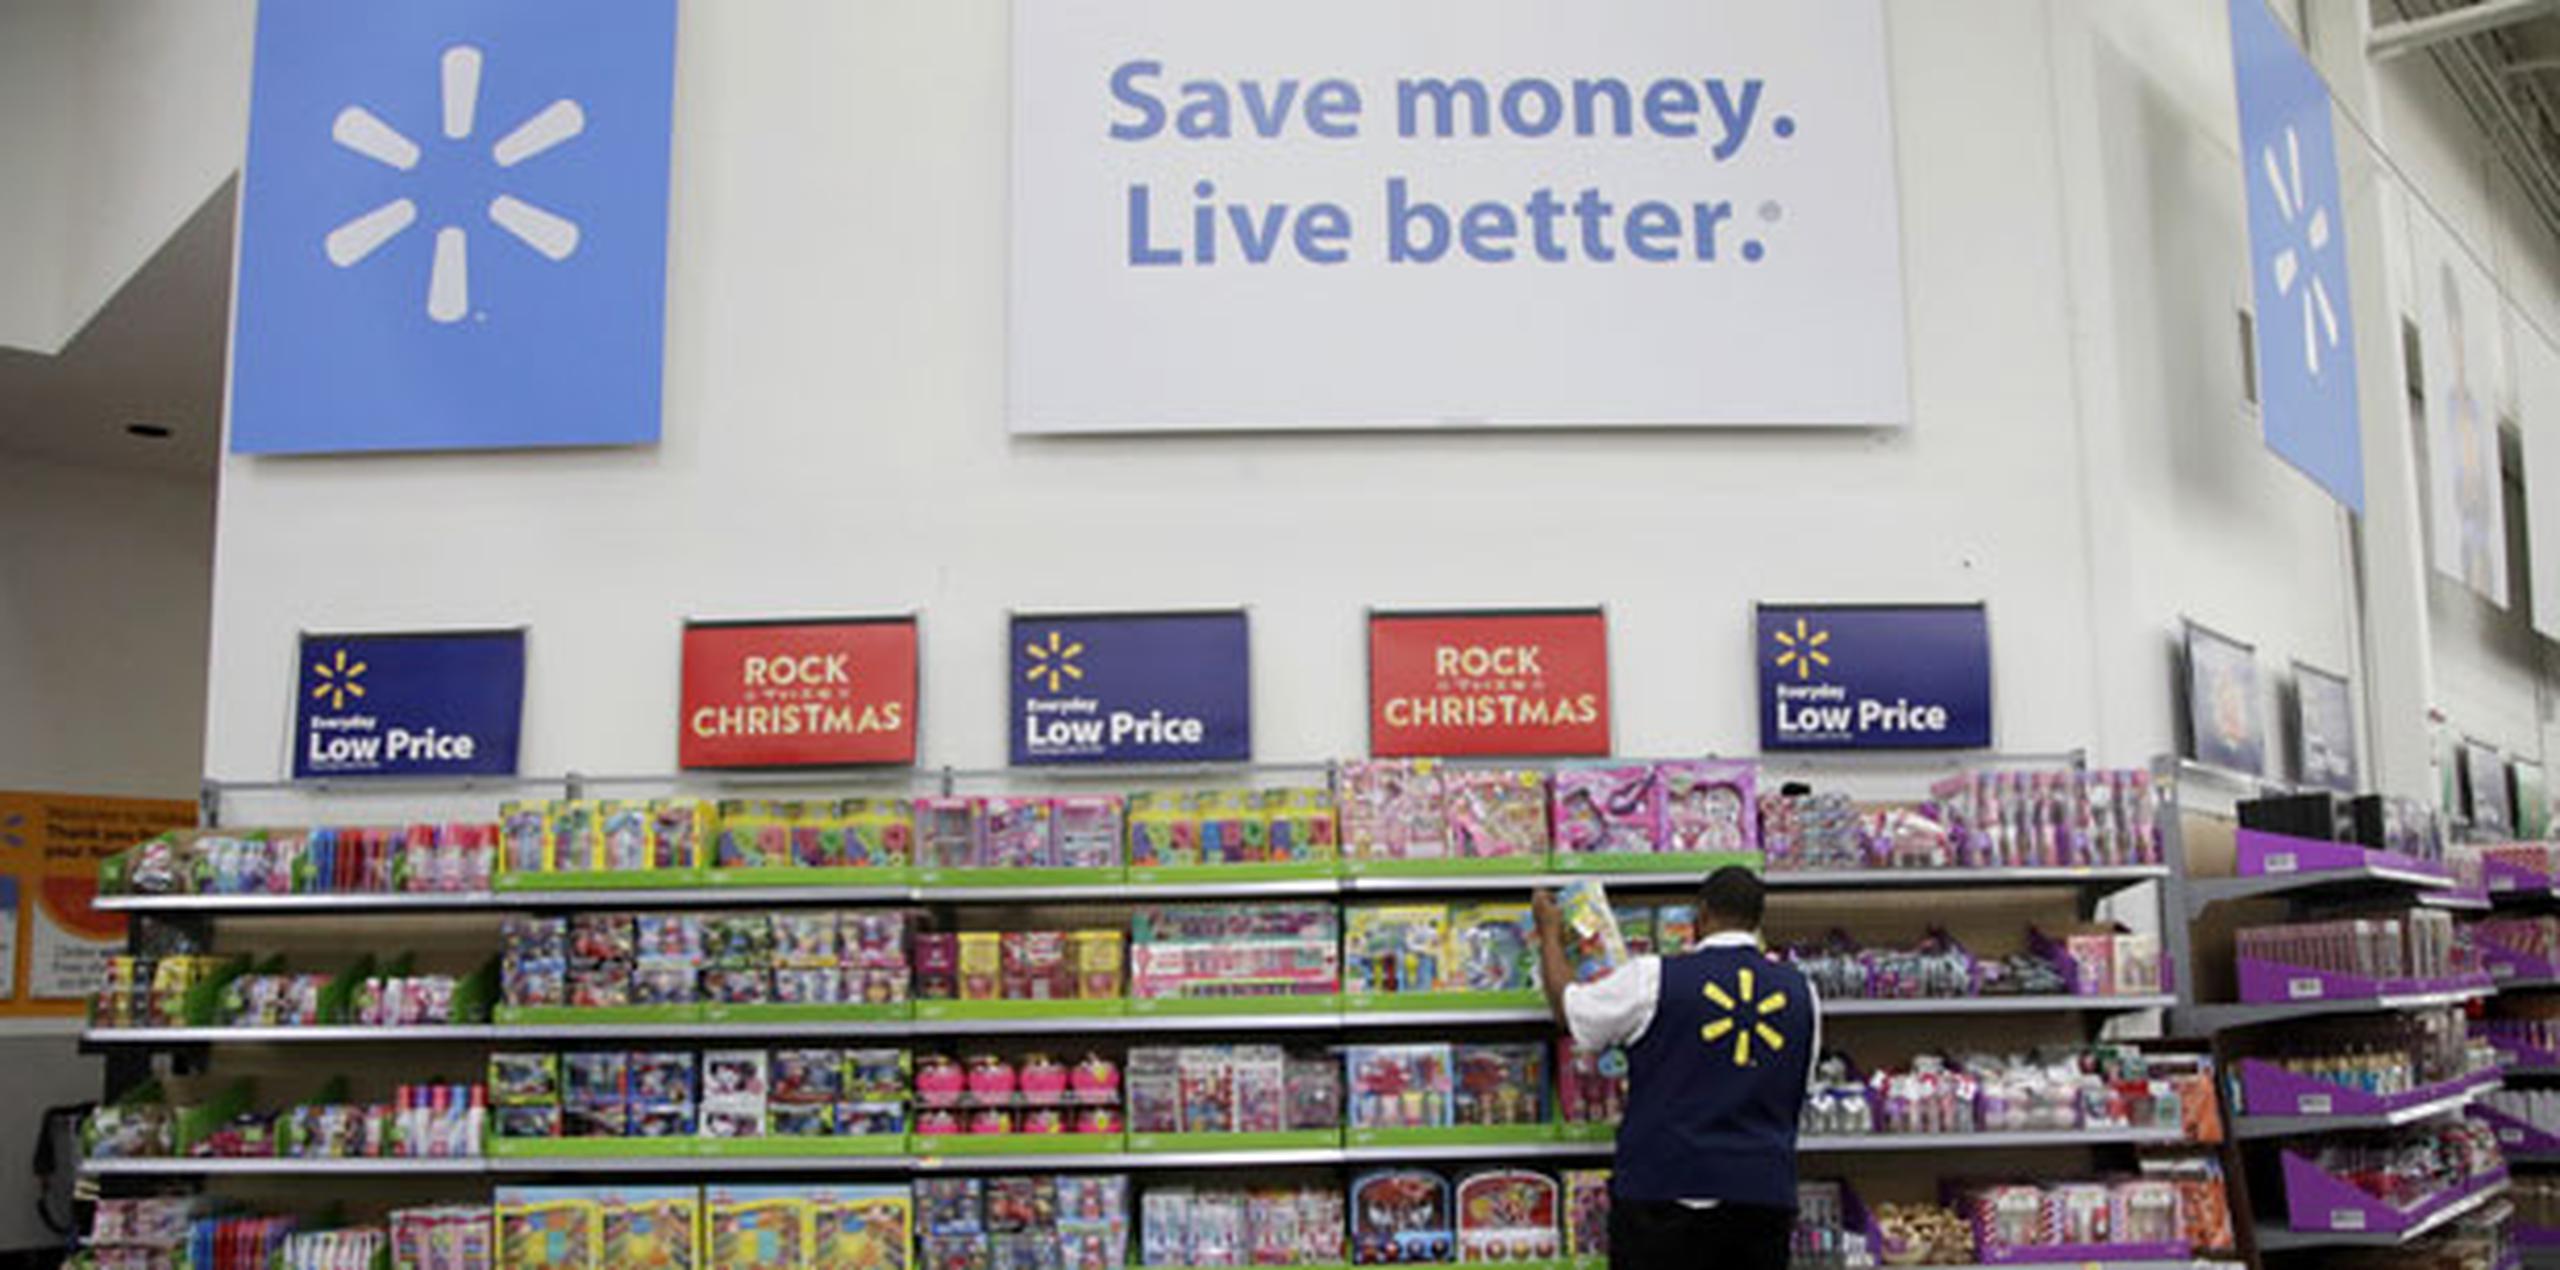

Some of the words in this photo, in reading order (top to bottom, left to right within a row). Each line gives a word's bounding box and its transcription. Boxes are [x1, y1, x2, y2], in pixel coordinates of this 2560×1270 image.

[1108, 60, 1363, 142] Save
[1395, 77, 1796, 162] money.
[1126, 179, 1353, 267] Live
[743, 652, 850, 686] ROCK
[1435, 645, 1542, 677] ROCK
[1026, 698, 1099, 715] Everyday
[1776, 684, 1846, 701] Everyday
[310, 716, 377, 732] Everyday
[692, 701, 902, 738] CHRISTMAS
[1383, 693, 1598, 727] CHRISTMAS
[1777, 701, 1852, 732] Low
[1858, 698, 1947, 731] Price
[309, 732, 381, 761] Low
[386, 727, 475, 760] Price
[1026, 715, 1104, 746] Low
[1110, 710, 1203, 744] Price
